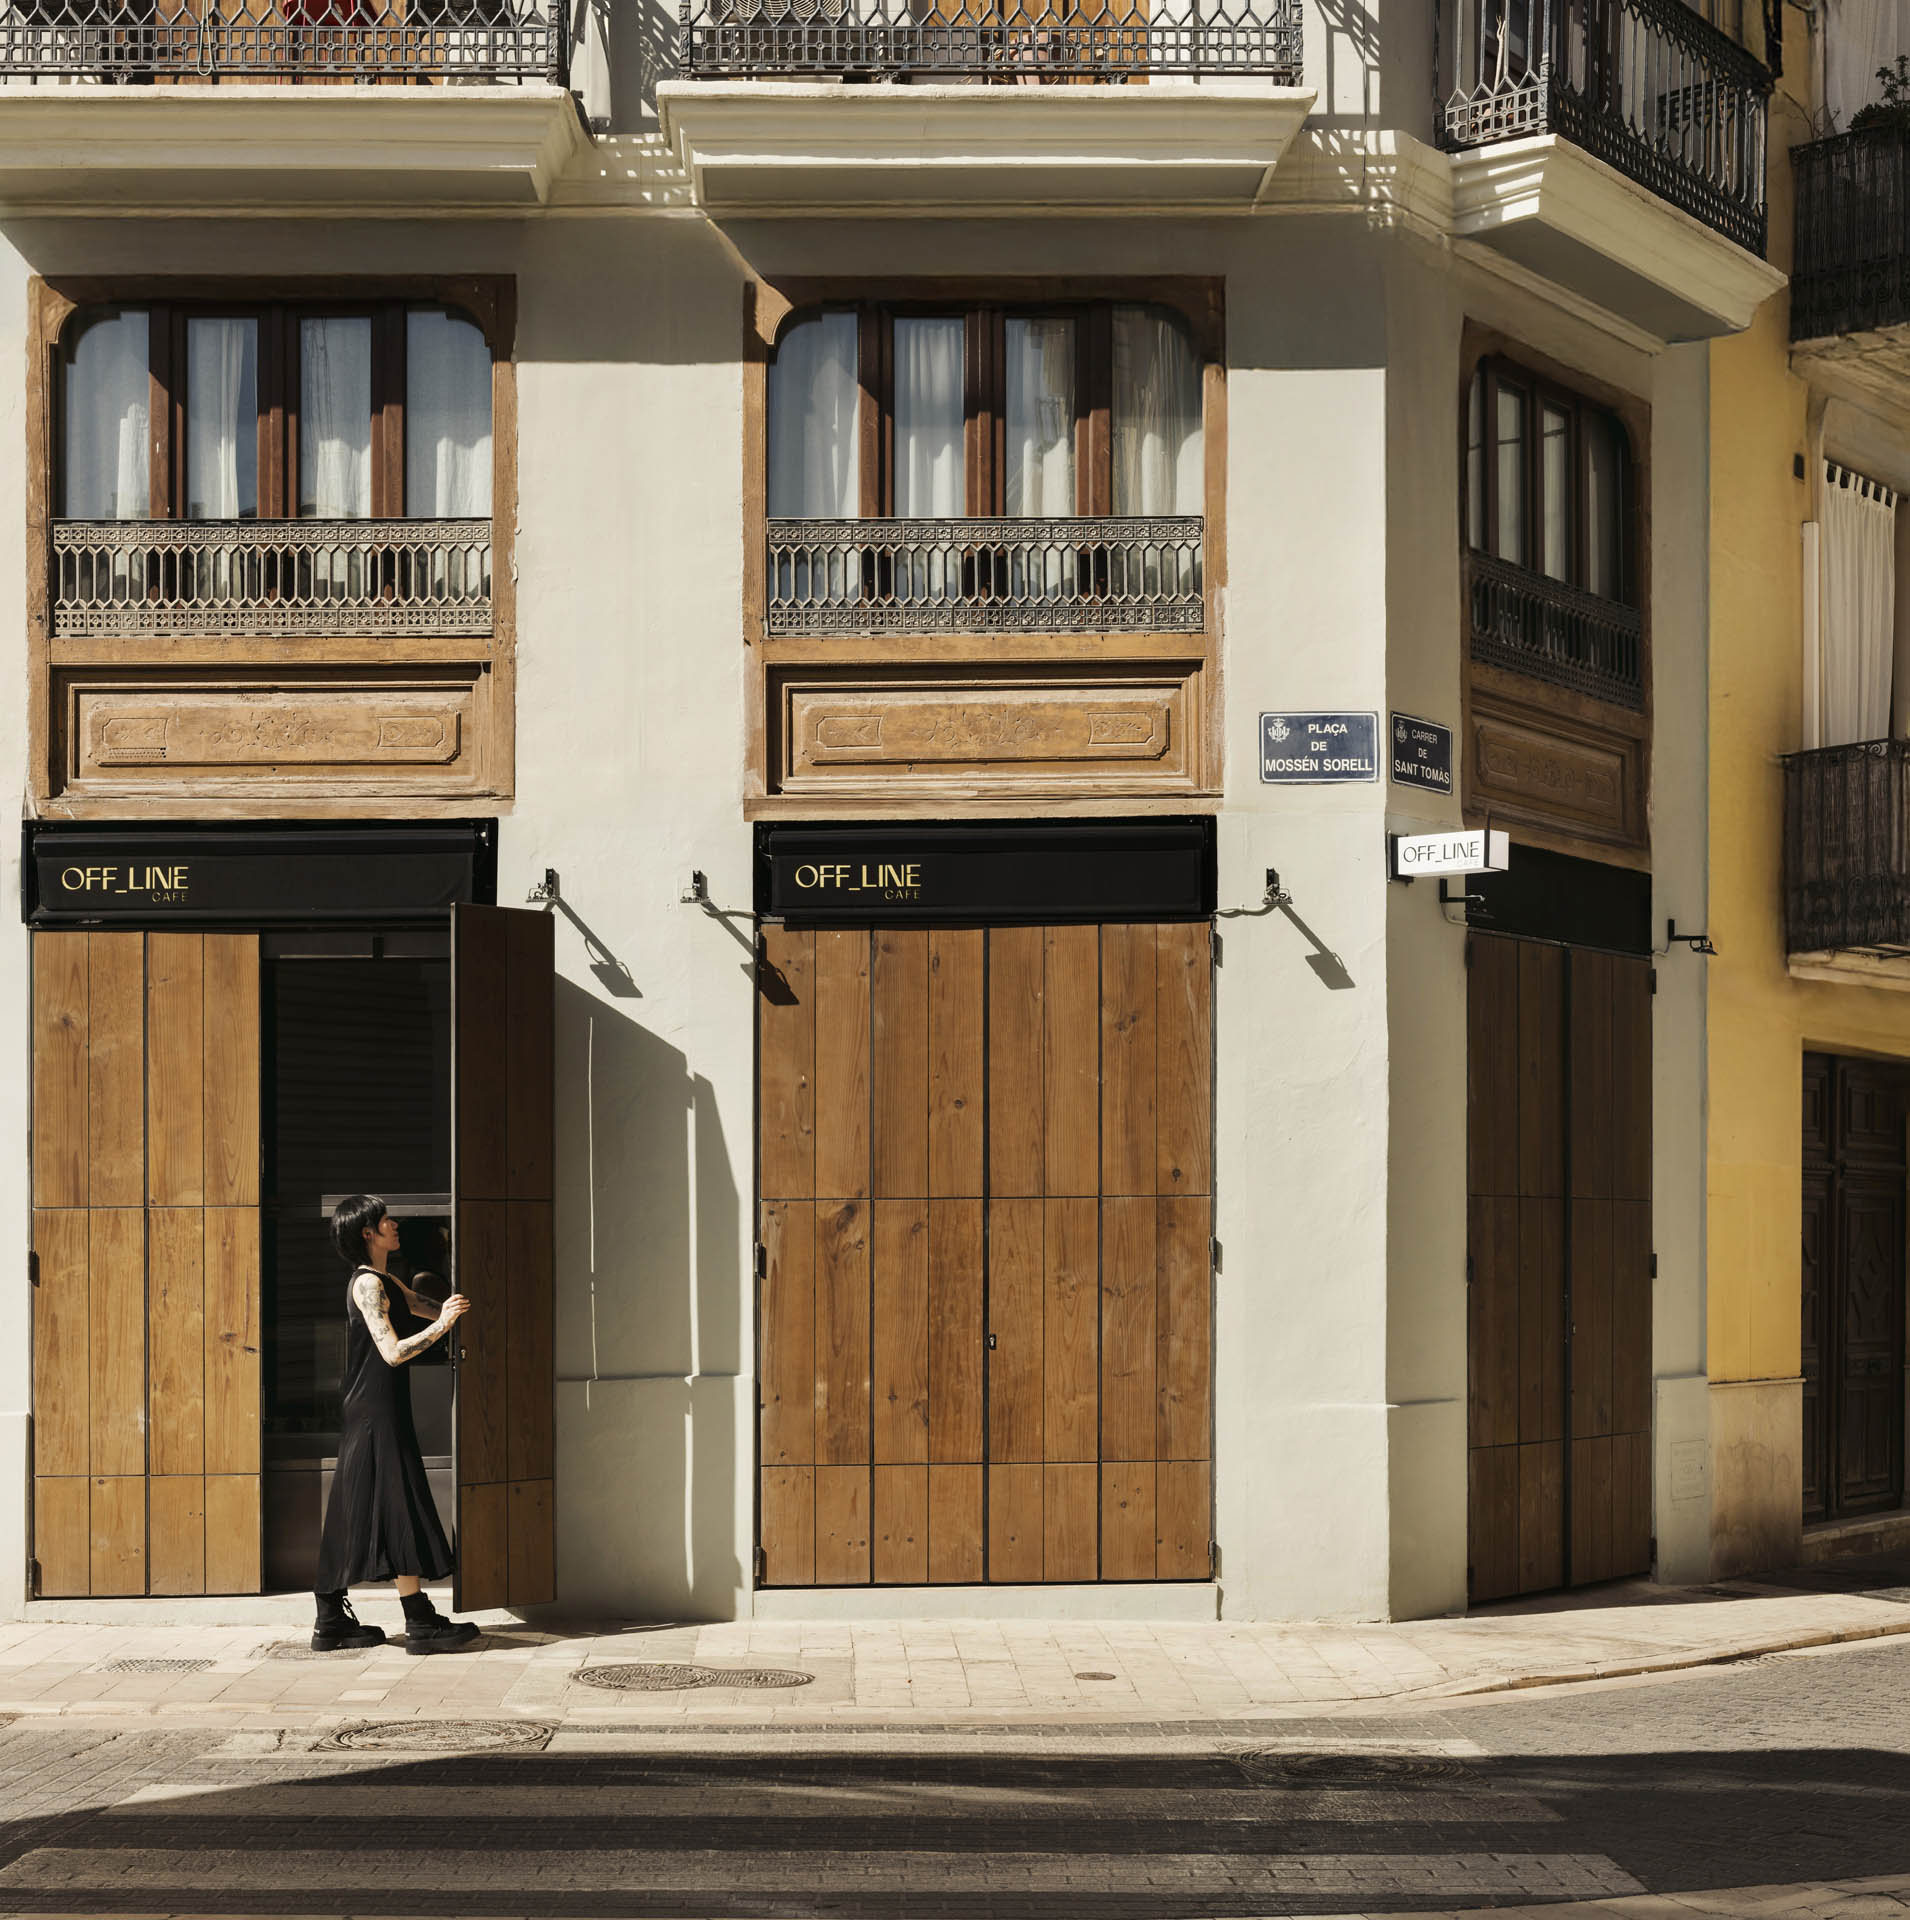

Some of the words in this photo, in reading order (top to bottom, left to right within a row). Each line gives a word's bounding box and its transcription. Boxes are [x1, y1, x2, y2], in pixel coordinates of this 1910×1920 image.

[1307, 723, 1348, 736] PLAÇA
[1411, 729, 1438, 745] CARRER
[1310, 741, 1328, 752] DE
[1418, 747, 1428, 759] DE
[1265, 755, 1319, 772] MOSSÉN
[1323, 758, 1373, 771] SORELL
[1394, 759, 1418, 776] SANT
[1420, 765, 1450, 784] TOMÀS
[1403, 840, 1480, 863] OFF_LINE
[61, 866, 189, 893] OFF_LINE
[795, 864, 921, 891] OFF_LINE
